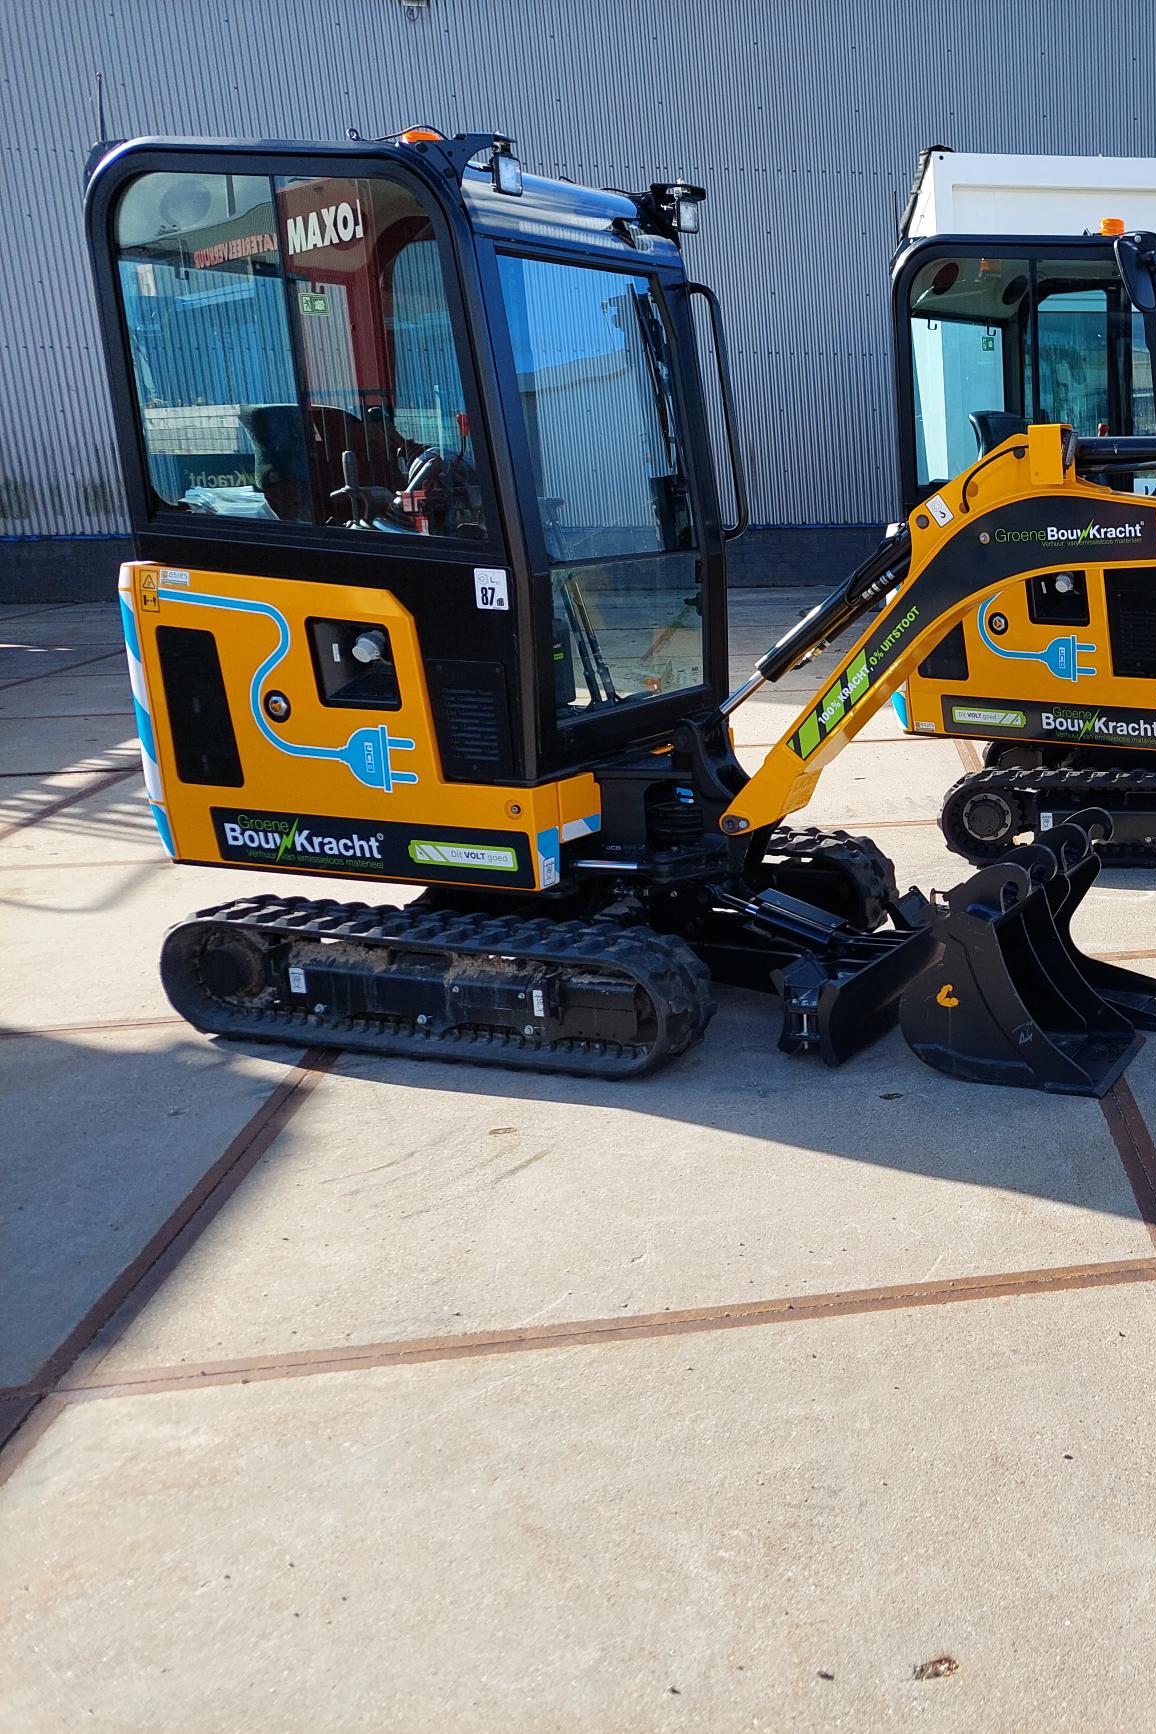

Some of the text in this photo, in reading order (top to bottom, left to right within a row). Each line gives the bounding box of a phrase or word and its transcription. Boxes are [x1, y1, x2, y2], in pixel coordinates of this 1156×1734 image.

[481, 587, 495, 606] 87
[818, 605, 920, 725] 100% KRACHT, 0% UITSTOOT
[364, 742, 375, 773] JCB
[237, 814, 289, 833] Groene
[451, 850, 508, 863] Dit VOLT goed
